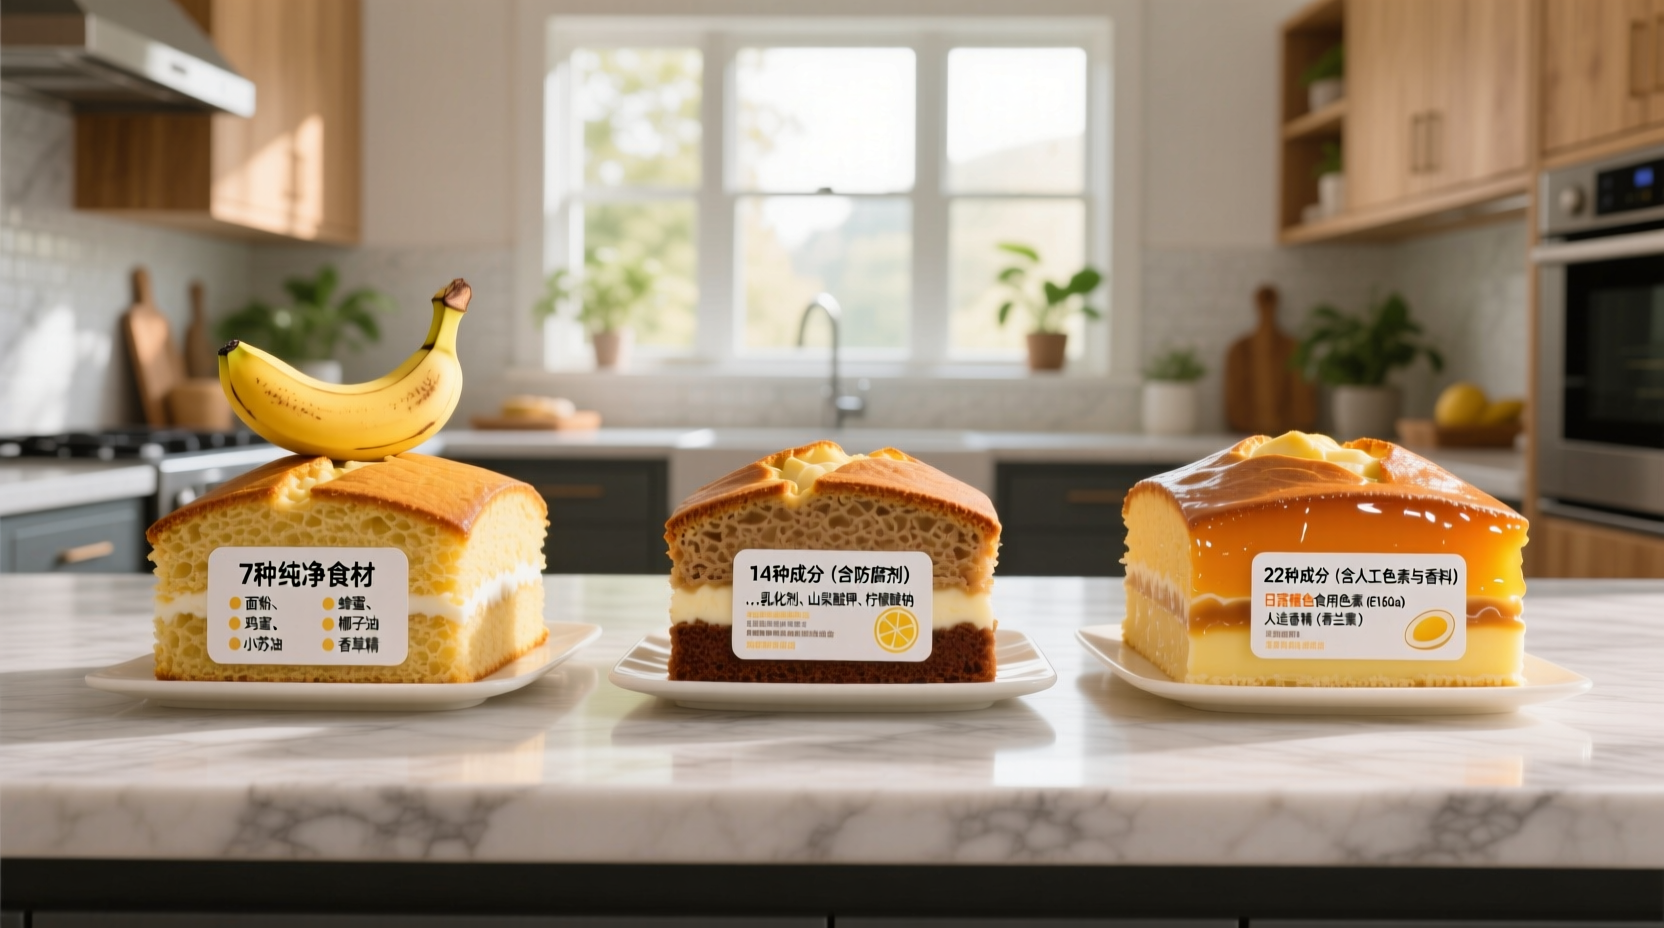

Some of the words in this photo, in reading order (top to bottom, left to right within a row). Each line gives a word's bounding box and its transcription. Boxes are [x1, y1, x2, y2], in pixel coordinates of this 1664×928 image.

[239, 560, 375, 588] 7种纯净食材
